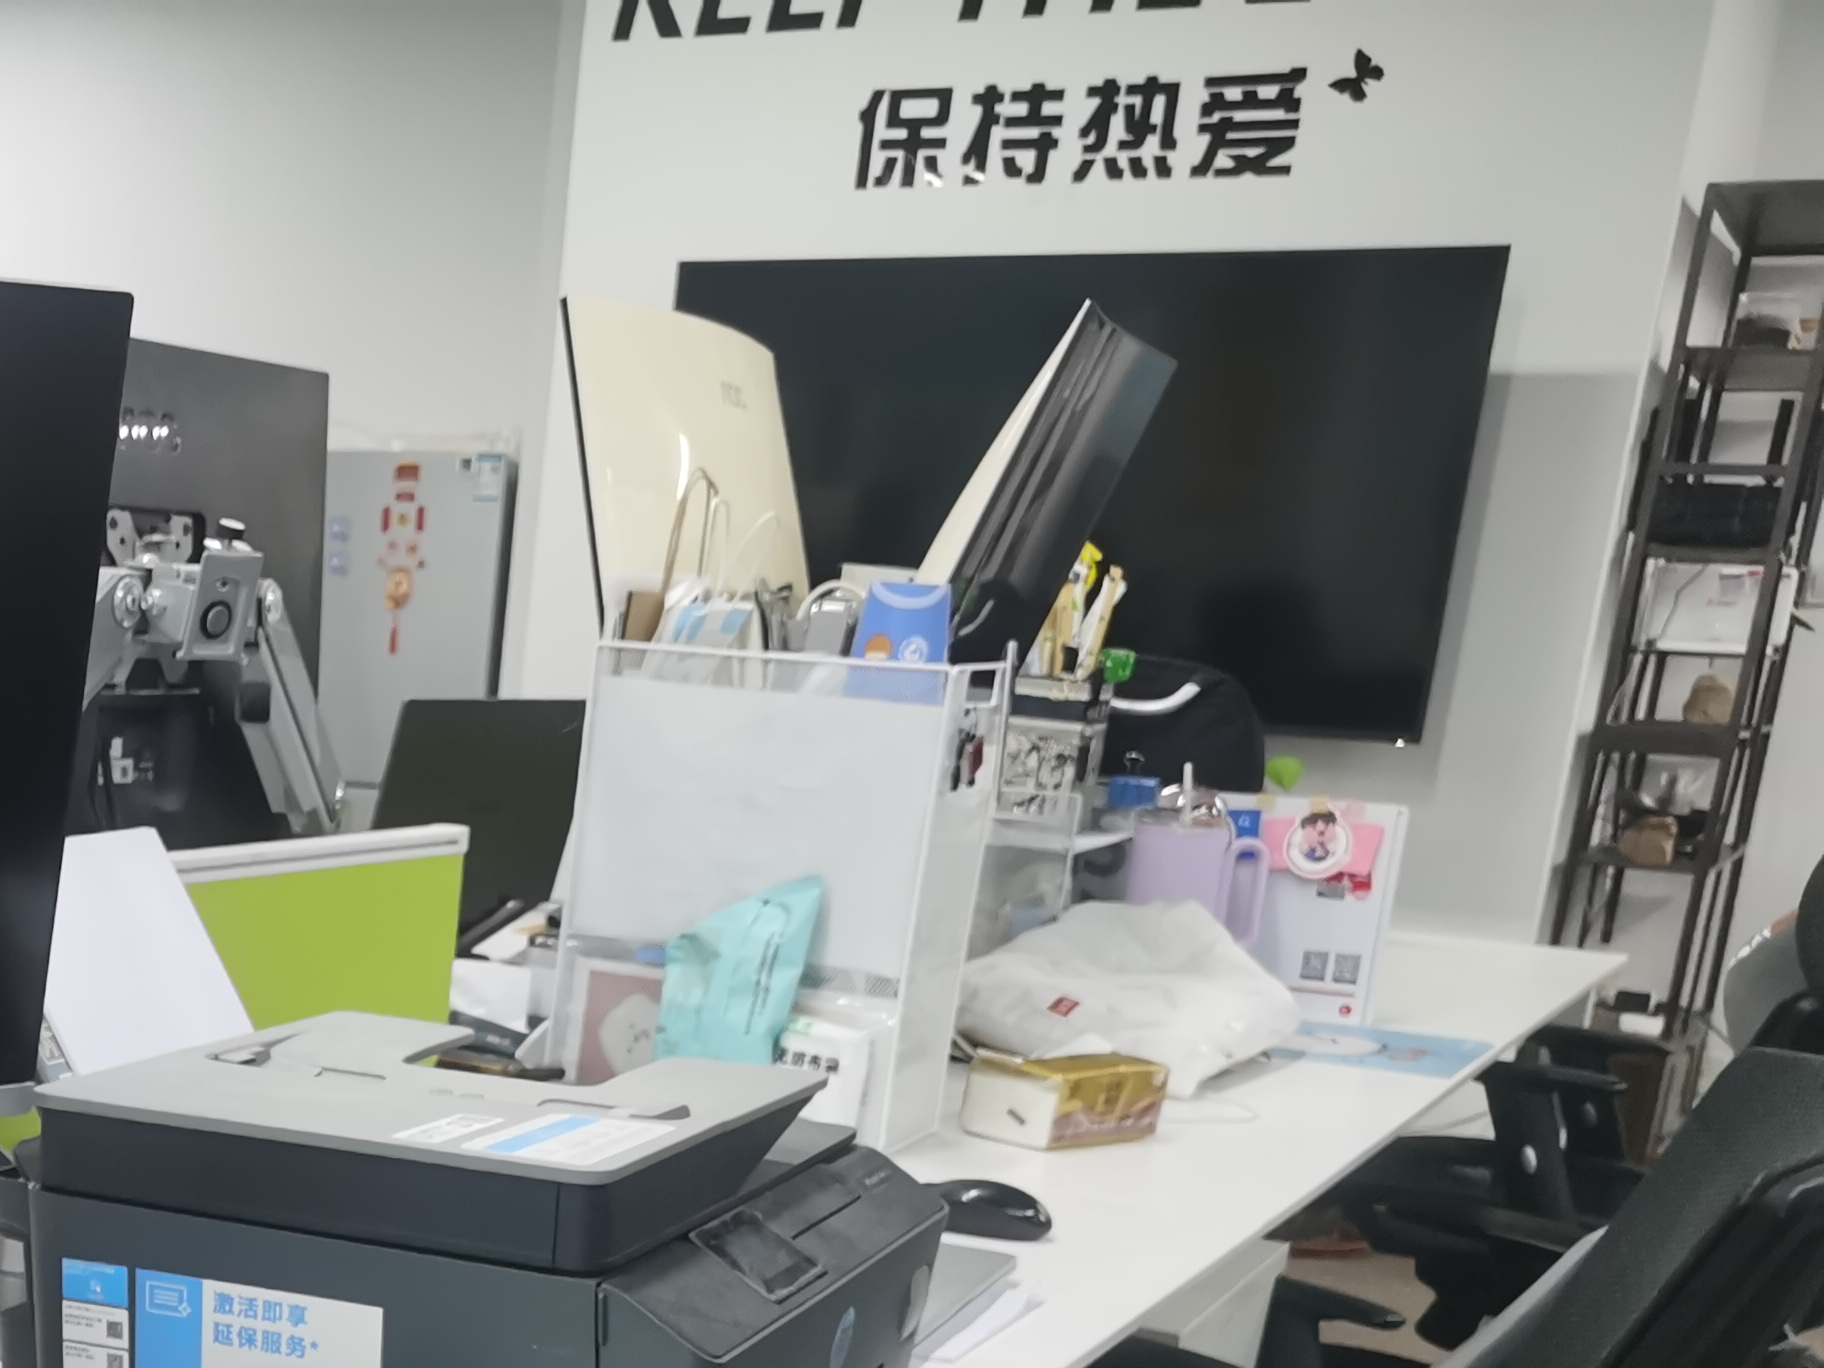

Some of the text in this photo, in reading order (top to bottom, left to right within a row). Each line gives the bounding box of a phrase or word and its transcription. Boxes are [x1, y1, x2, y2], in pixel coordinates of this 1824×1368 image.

[854, 66, 1308, 191] 保持热爱
[213, 1290, 308, 1328] 激活即享
